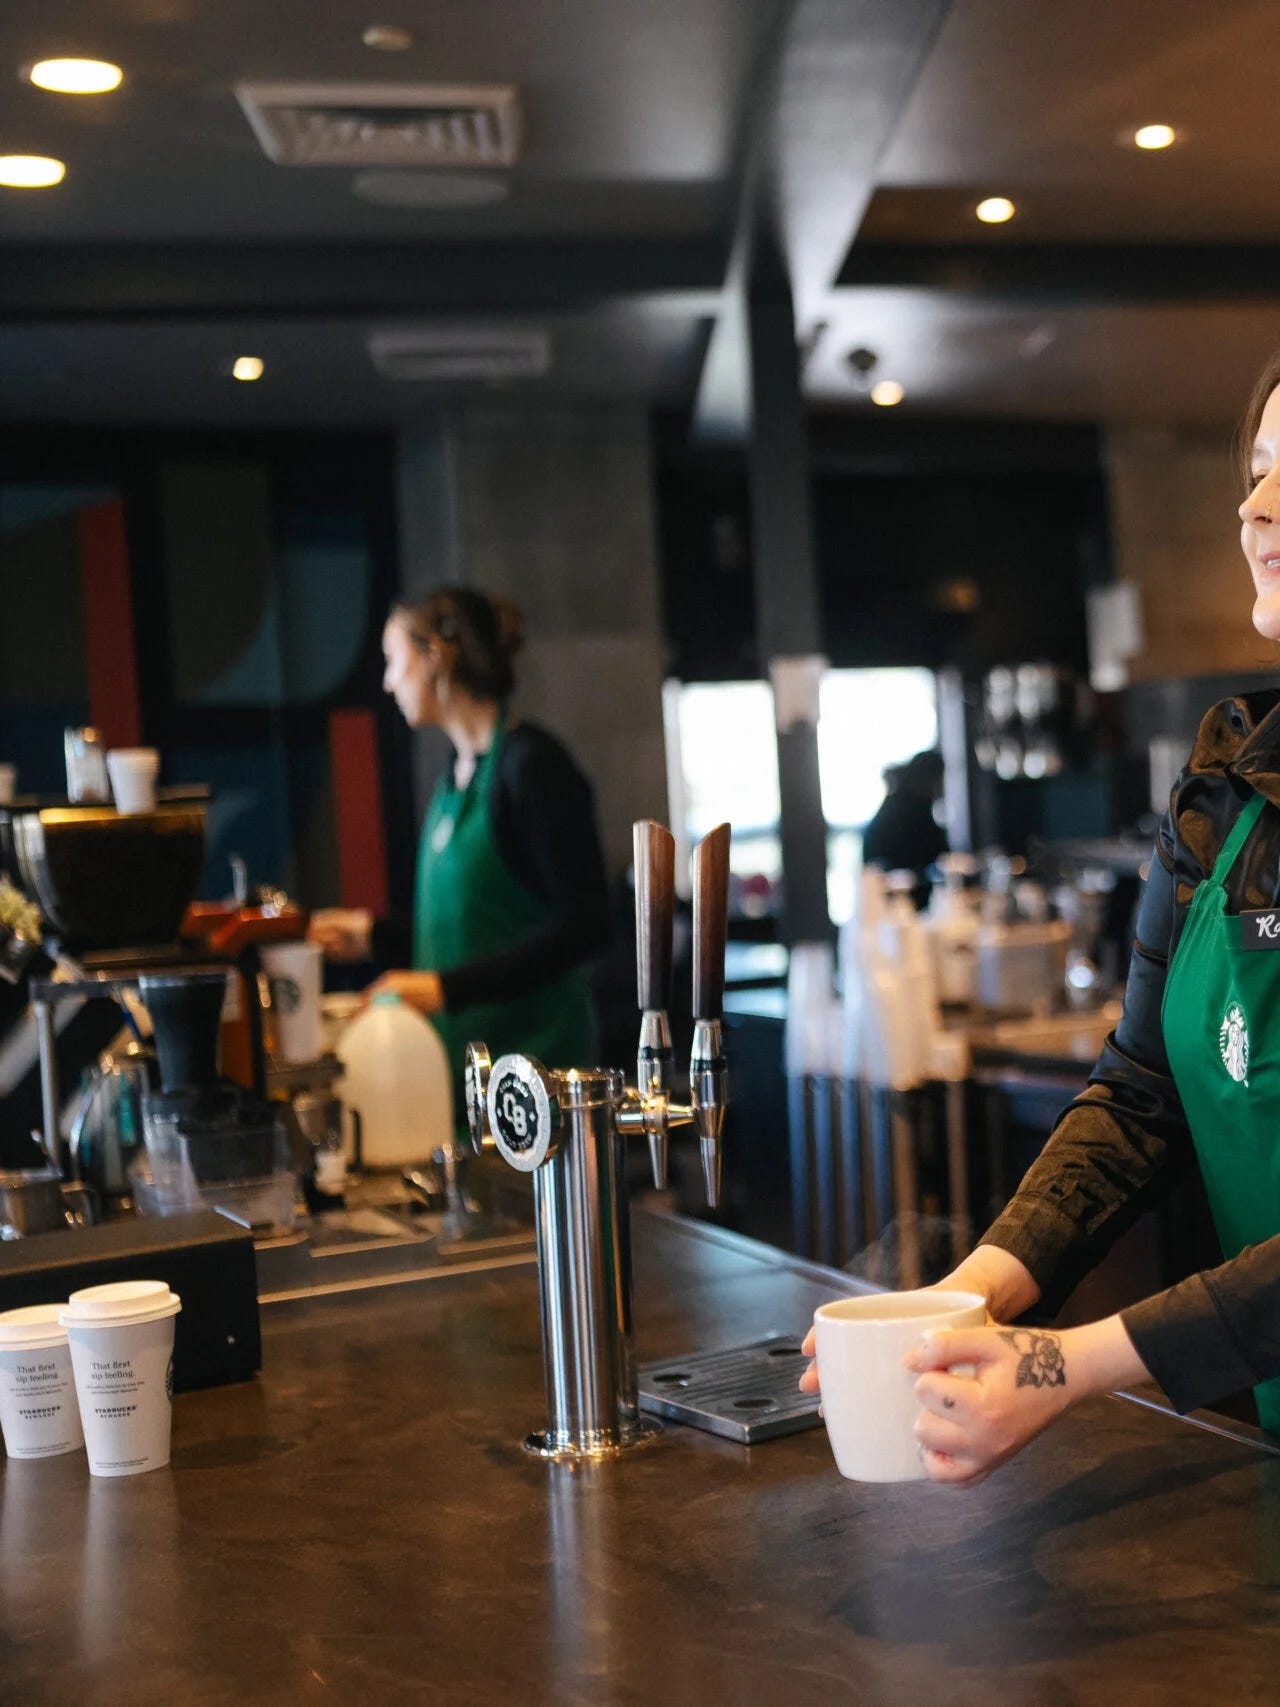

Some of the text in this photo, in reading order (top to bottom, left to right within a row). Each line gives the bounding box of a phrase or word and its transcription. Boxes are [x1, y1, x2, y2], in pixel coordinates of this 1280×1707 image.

[16, 1363, 56, 1374] That first
[91, 1360, 131, 1371] That first
